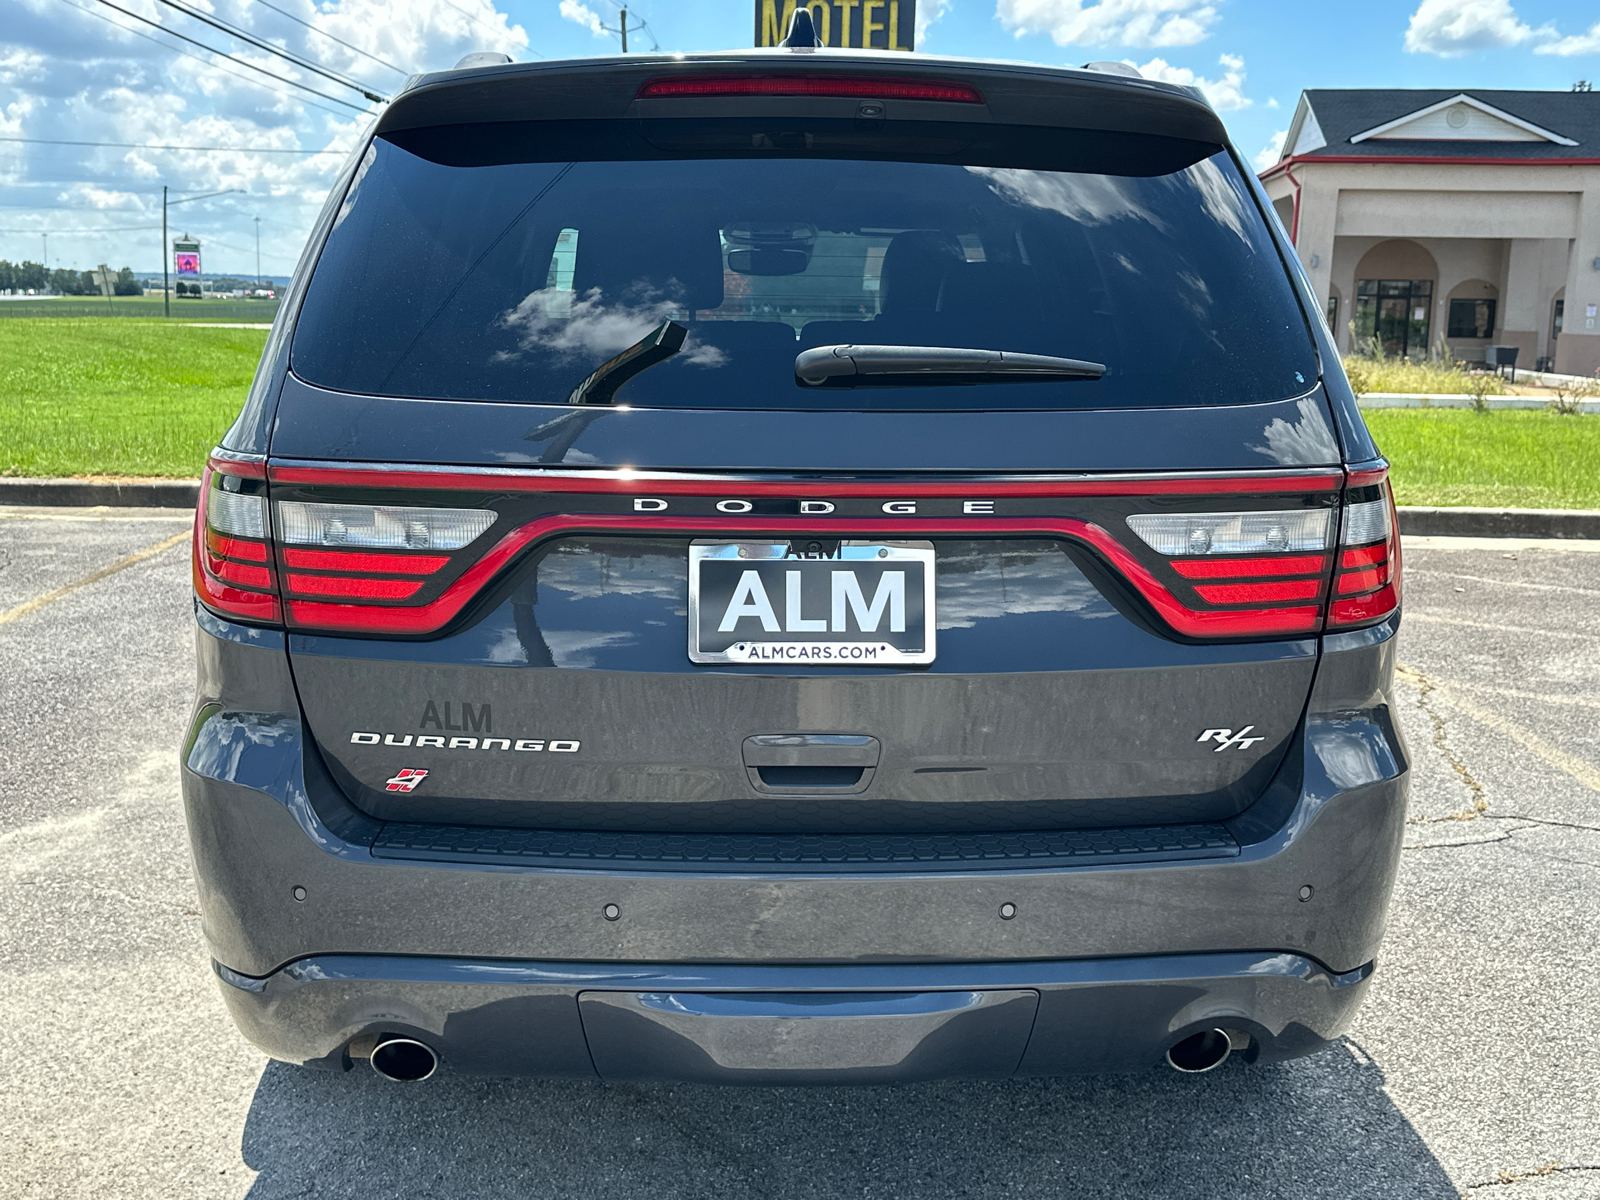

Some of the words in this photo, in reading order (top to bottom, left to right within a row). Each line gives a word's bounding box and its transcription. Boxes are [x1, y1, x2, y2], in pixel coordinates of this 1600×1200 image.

[761, 0, 909, 50] MOTEL
[633, 498, 995, 514] DODGE
[717, 570, 906, 633] ALM
[748, 646, 877, 659] ALMCARS.COM
[419, 699, 492, 733] ALM
[350, 731, 581, 752] DURANGO
[1197, 725, 1266, 752] R/T
